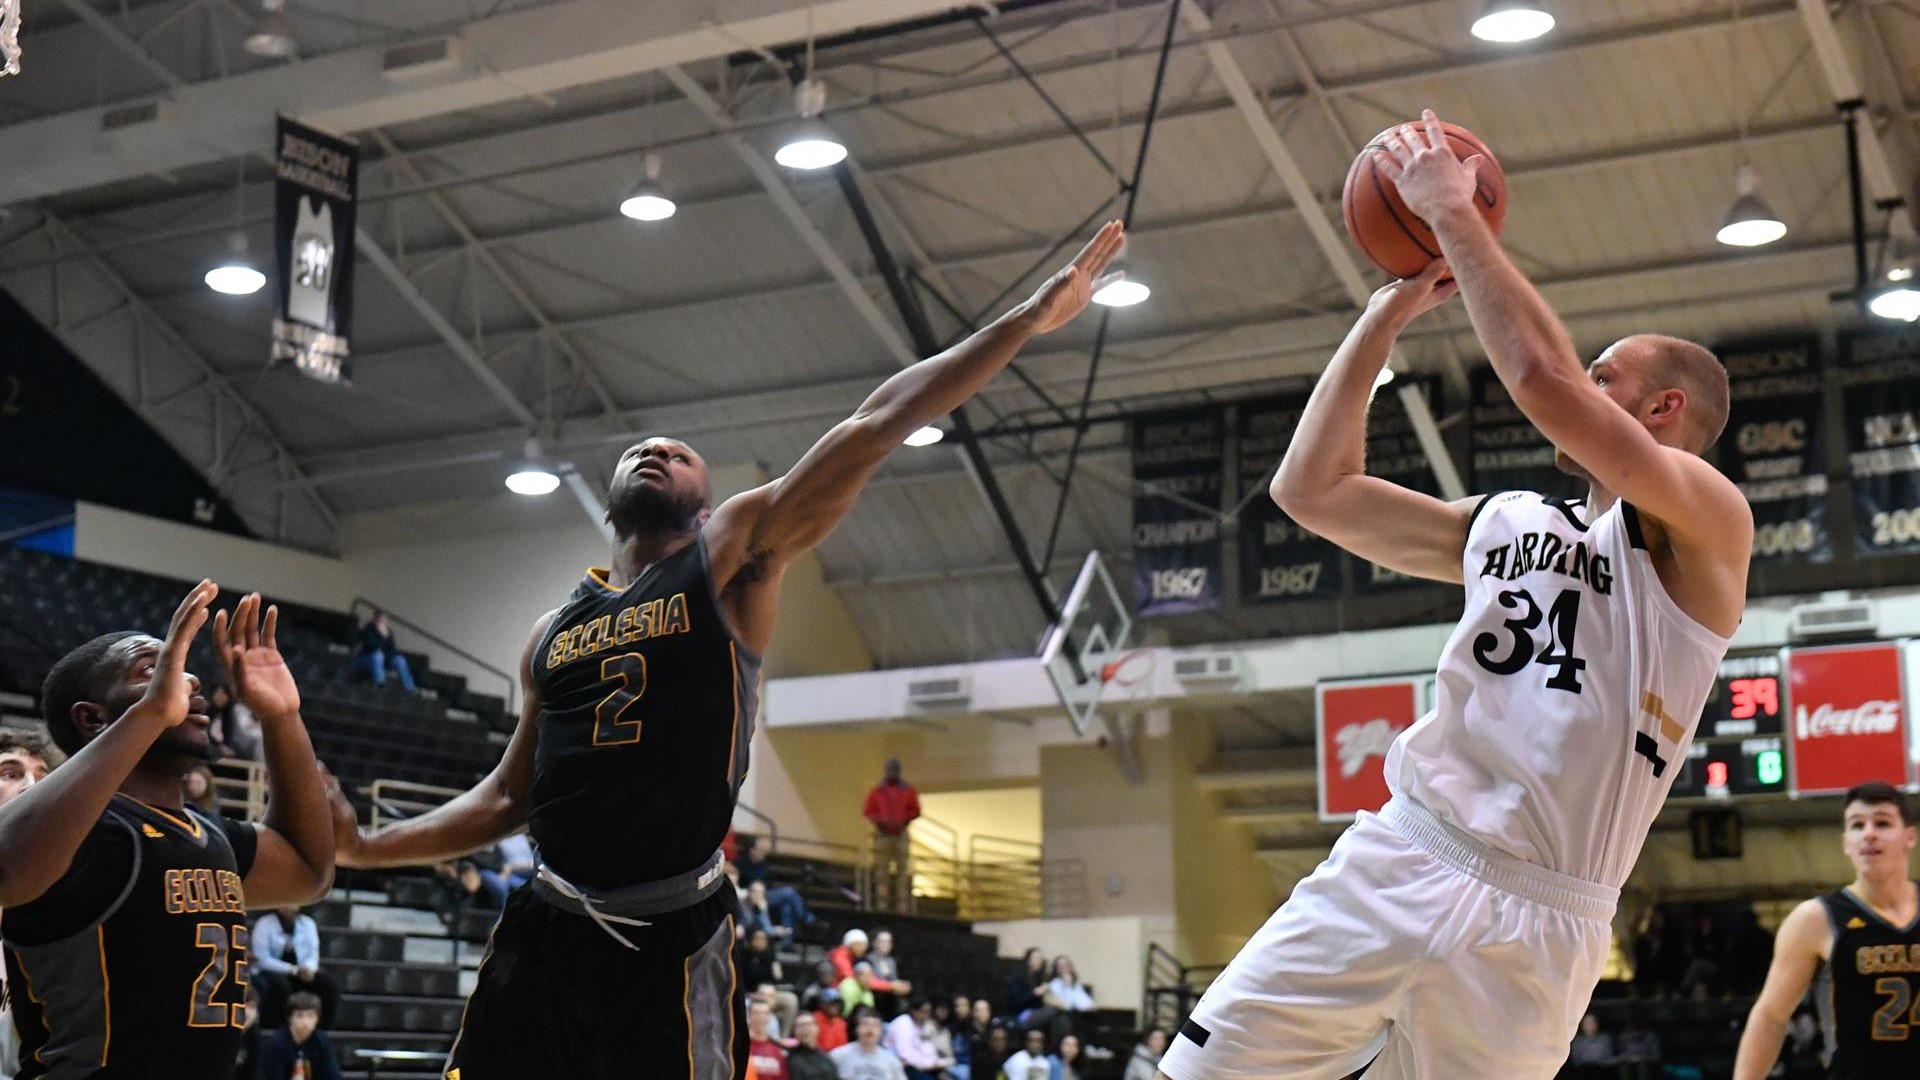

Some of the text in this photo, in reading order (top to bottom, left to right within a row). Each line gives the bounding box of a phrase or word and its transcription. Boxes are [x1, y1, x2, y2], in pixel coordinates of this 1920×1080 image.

[1864, 412, 1920, 447] NCA
[1261, 562, 1322, 598] 1987
[1480, 531, 1613, 596] HARDING
[546, 592, 690, 669] ECCLESIA
[1473, 589, 1586, 695] 34
[593, 652, 647, 746] 2
[1729, 677, 1779, 719] 39
[164, 869, 246, 916] ECCLES
[1856, 942, 1920, 975] ECCLE
